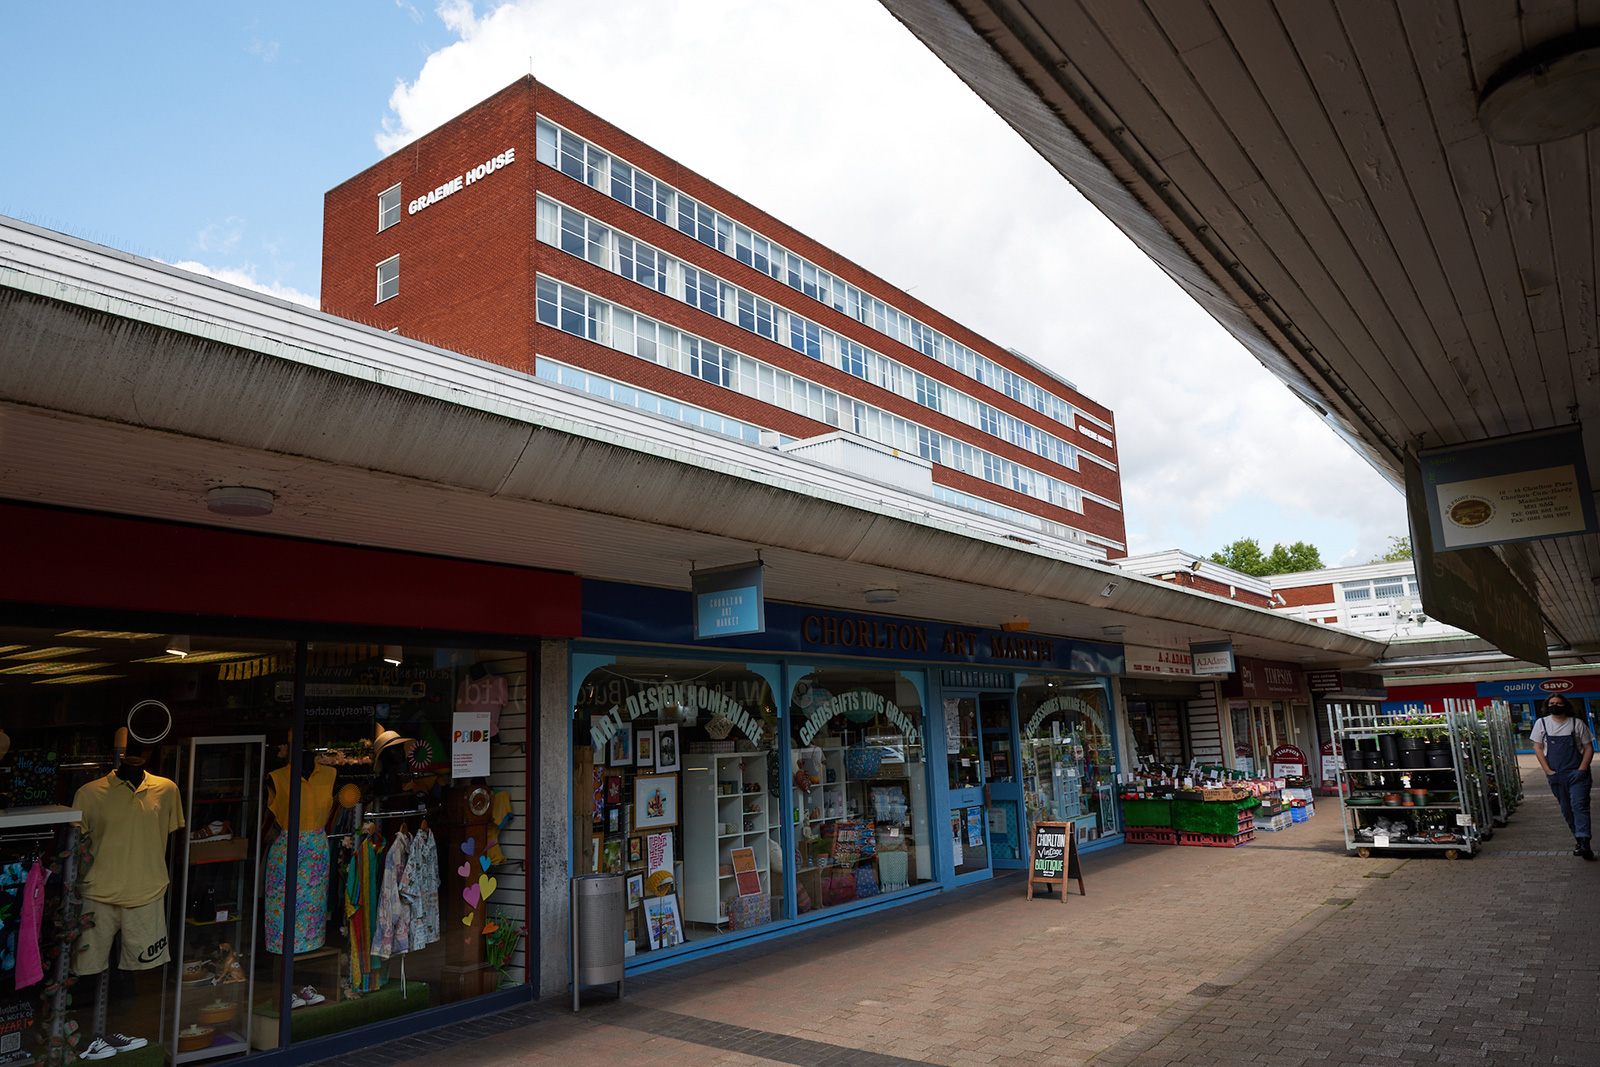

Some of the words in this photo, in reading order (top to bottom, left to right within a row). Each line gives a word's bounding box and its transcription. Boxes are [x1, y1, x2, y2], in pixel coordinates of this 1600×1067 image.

[408, 175, 464, 215] GRAEME
[465, 147, 515, 186] HOUSE
[1522, 483, 1552, 492] Chorlton
[1518, 495, 1558, 504] Manchester
[710, 596, 743, 608] CHORLTON
[722, 607, 732, 617] ART
[716, 616, 739, 628] MARKET
[802, 615, 928, 652] CHORLTON
[943, 629, 977, 656] ART
[990, 634, 1056, 662] MARKET
[1264, 667, 1293, 685] TIMPSON
[1504, 683, 1536, 693] quality
[1543, 681, 1569, 690] save
[1059, 696, 1081, 712] VINTAGE
[589, 704, 624, 750] ART
[625, 684, 686, 720] DESIGN
[686, 685, 765, 748] HOMEWARE
[799, 700, 834, 746] CARDS
[831, 691, 860, 716] GIFTS
[861, 691, 885, 714] TOYS
[885, 700, 918, 744] CRAFTS
[454, 730, 489, 743] PRIDE
[1275, 748, 1300, 757] TIMPSON
[17, 757, 34, 769] Here
[14, 776, 27, 788] the
[24, 786, 48, 800] Sun
[1036, 833, 1067, 848] CHORLTON
[1037, 847, 1063, 860] Vintage
[1035, 859, 1064, 872] BOUTIQUE
[0, 1018, 28, 1035] HEART
